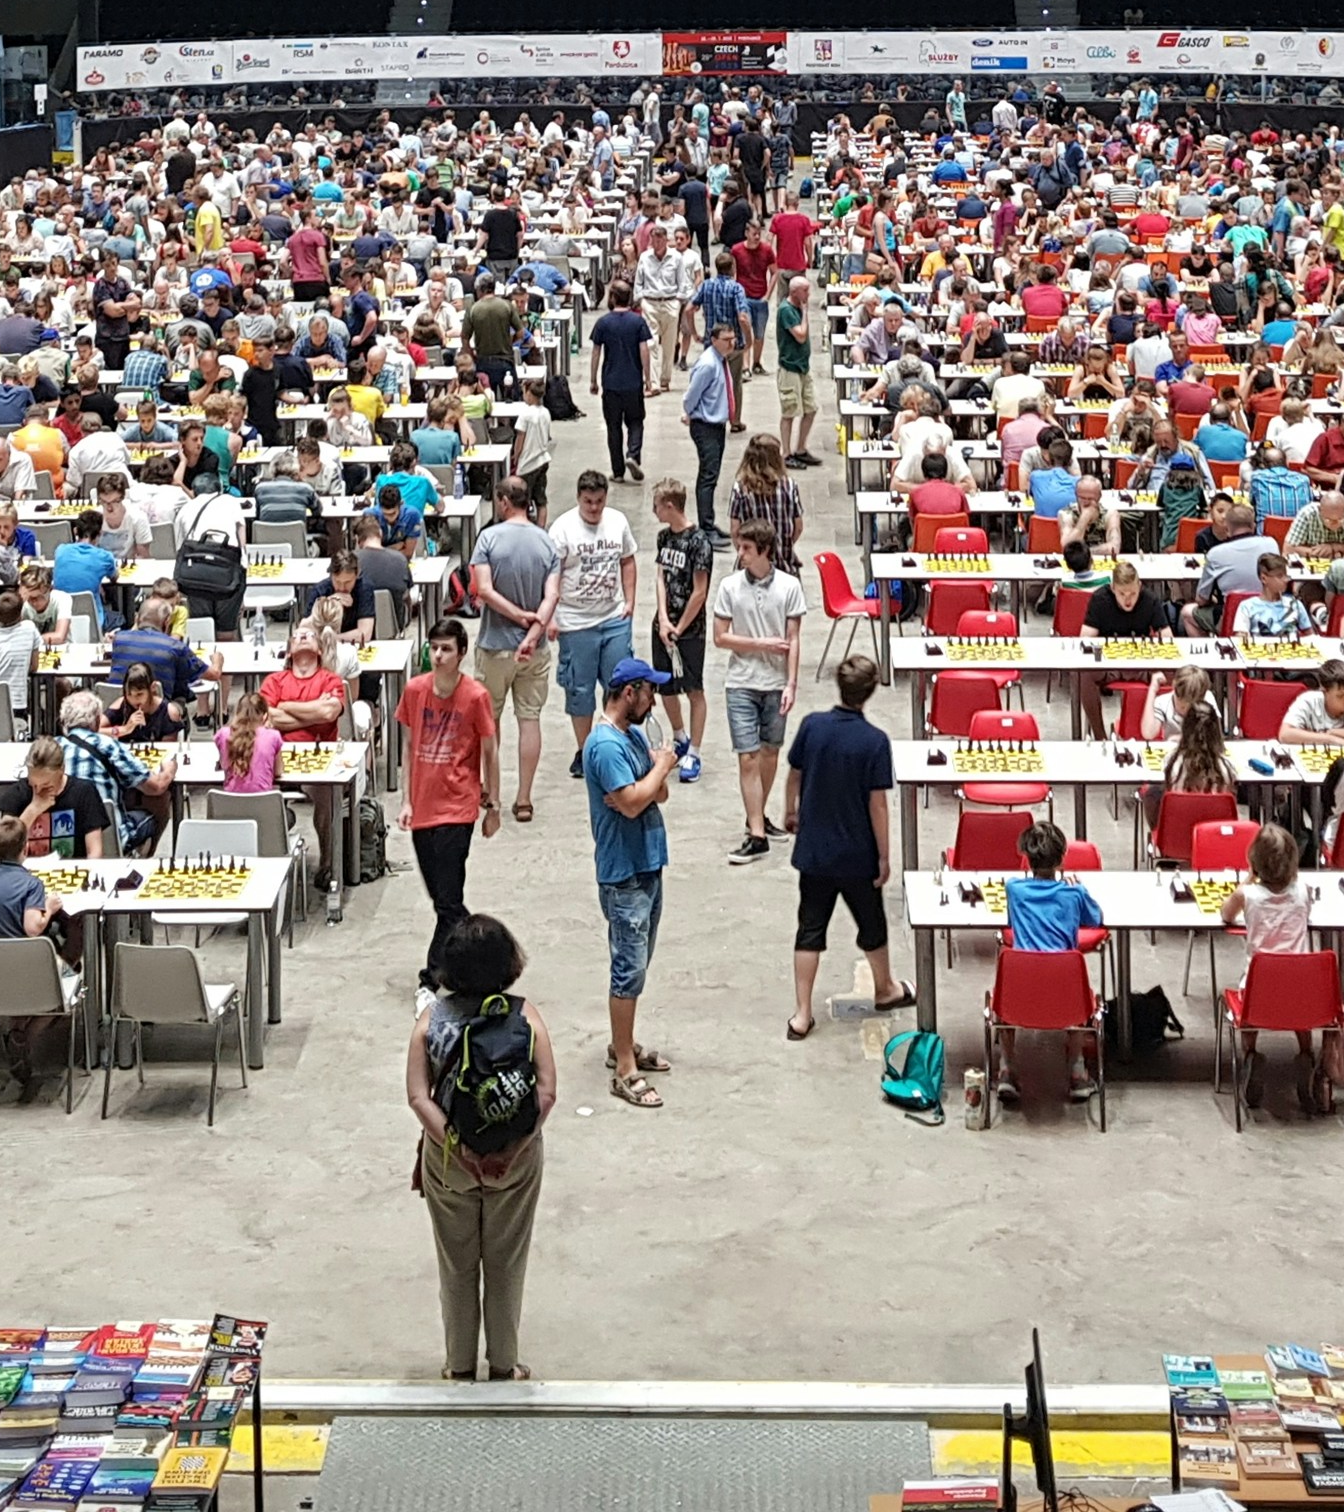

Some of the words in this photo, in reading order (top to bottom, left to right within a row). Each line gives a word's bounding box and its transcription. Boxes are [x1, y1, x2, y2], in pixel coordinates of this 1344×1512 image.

[1177, 37, 1211, 48] GASCO
[84, 48, 123, 59] PARAMO
[714, 45, 738, 53] CZECH
[293, 50, 314, 58] RSM
[928, 53, 959, 62] SLUŽBY
